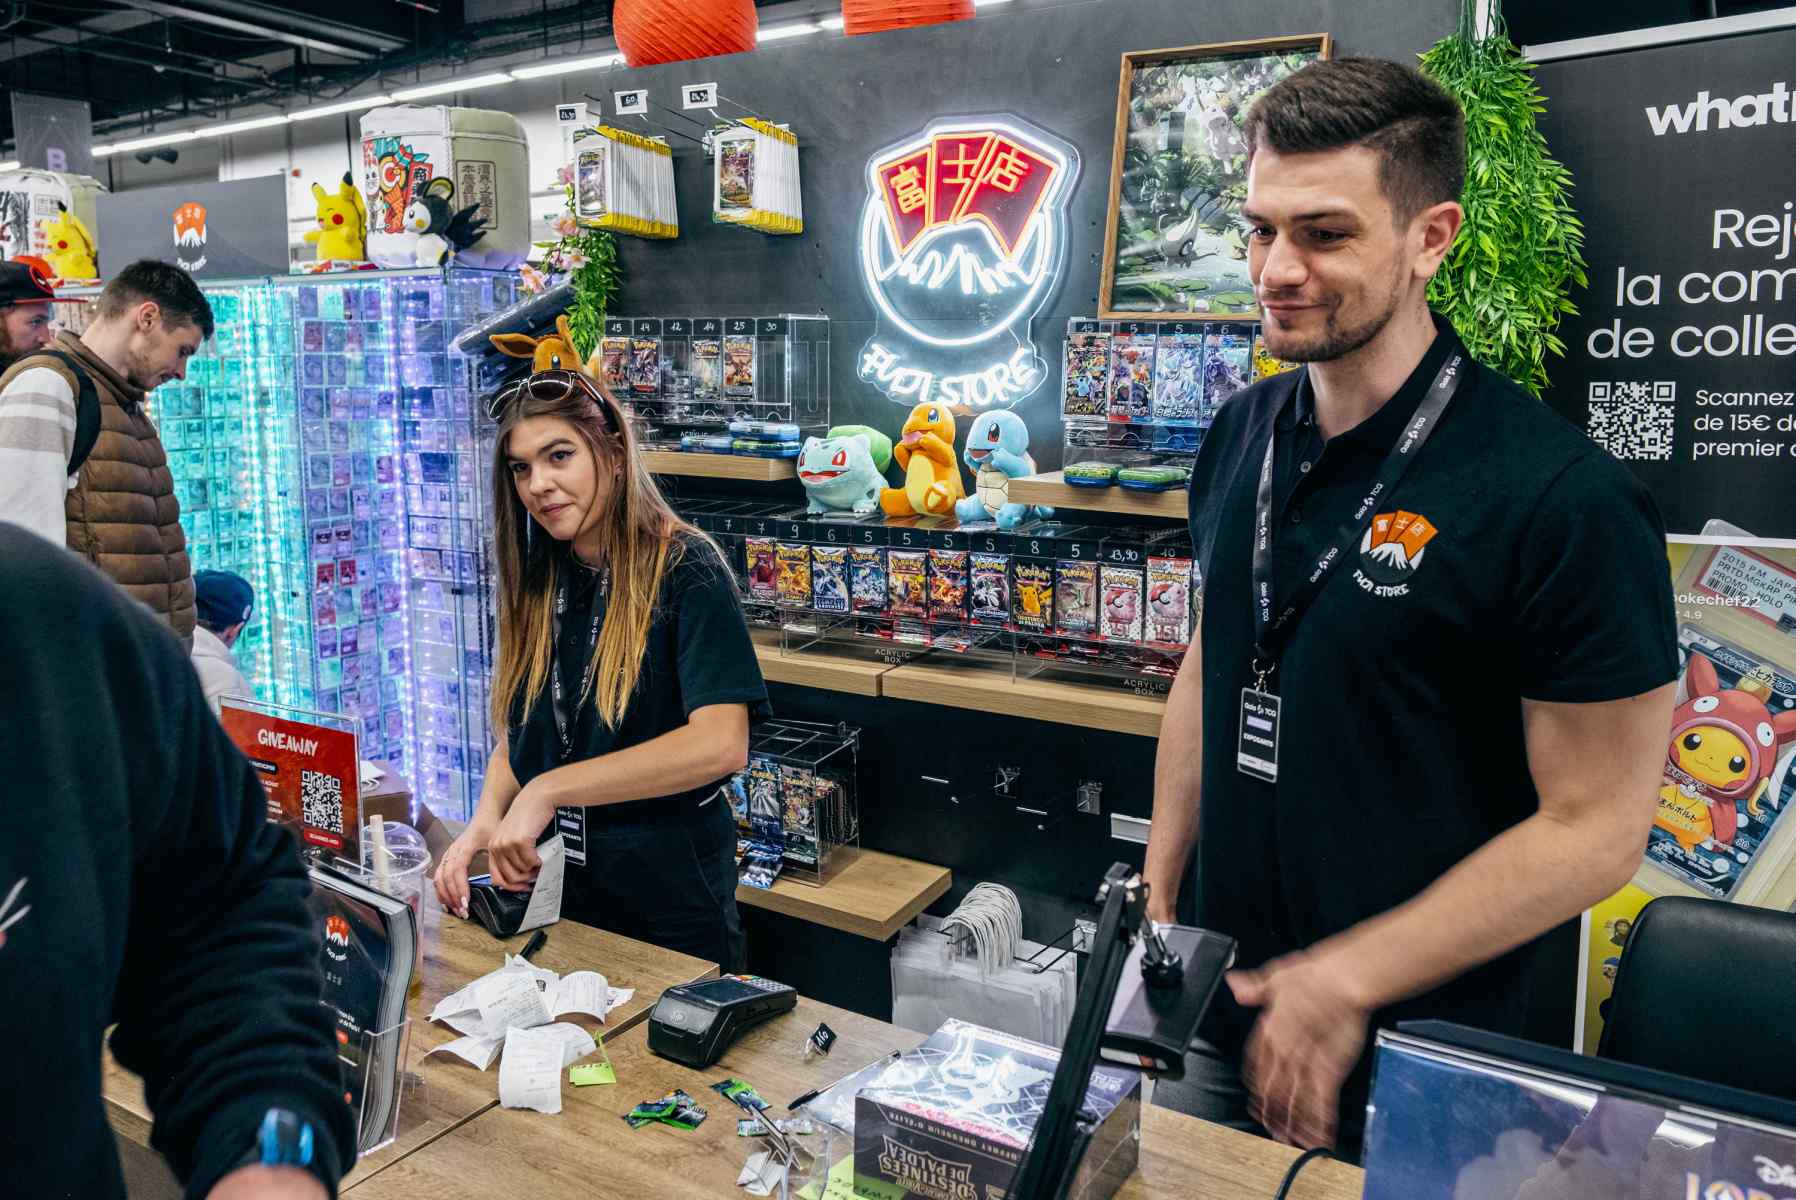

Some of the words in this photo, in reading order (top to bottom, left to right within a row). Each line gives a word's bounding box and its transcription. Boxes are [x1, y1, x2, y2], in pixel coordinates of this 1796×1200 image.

[1646, 82, 1796, 136] what
[1712, 201, 1796, 260] Rej
[1617, 267, 1661, 307] la
[1129, 323, 1138, 333] 5
[1175, 323, 1184, 334] 5
[1587, 318, 1655, 359] de
[936, 347, 1038, 406] STORE
[1695, 389, 1795, 407] Scannez
[1694, 413, 1724, 431] de
[1729, 414, 1771, 431] 15€
[1693, 438, 1785, 461] premier
[791, 523, 799, 538] 9
[827, 529, 836, 541] 6
[864, 531, 873, 543] 5
[903, 533, 911, 545] 5
[944, 535, 953, 548] 5
[985, 539, 995, 551] 5
[1031, 541, 1040, 554] 8
[1071, 544, 1080, 558] 5
[1374, 583, 1409, 597] STORE
[1683, 611, 1702, 620] 4.9
[1155, 623, 1183, 641] 151
[875, 649, 911, 658] ACRYLIC
[884, 655, 901, 664] BOX
[1123, 679, 1167, 691] ACRYLIC
[1135, 687, 1156, 697] BOX
[257, 728, 319, 757] GIVEAWAY
[889, 1143, 947, 1177] PALDEA
